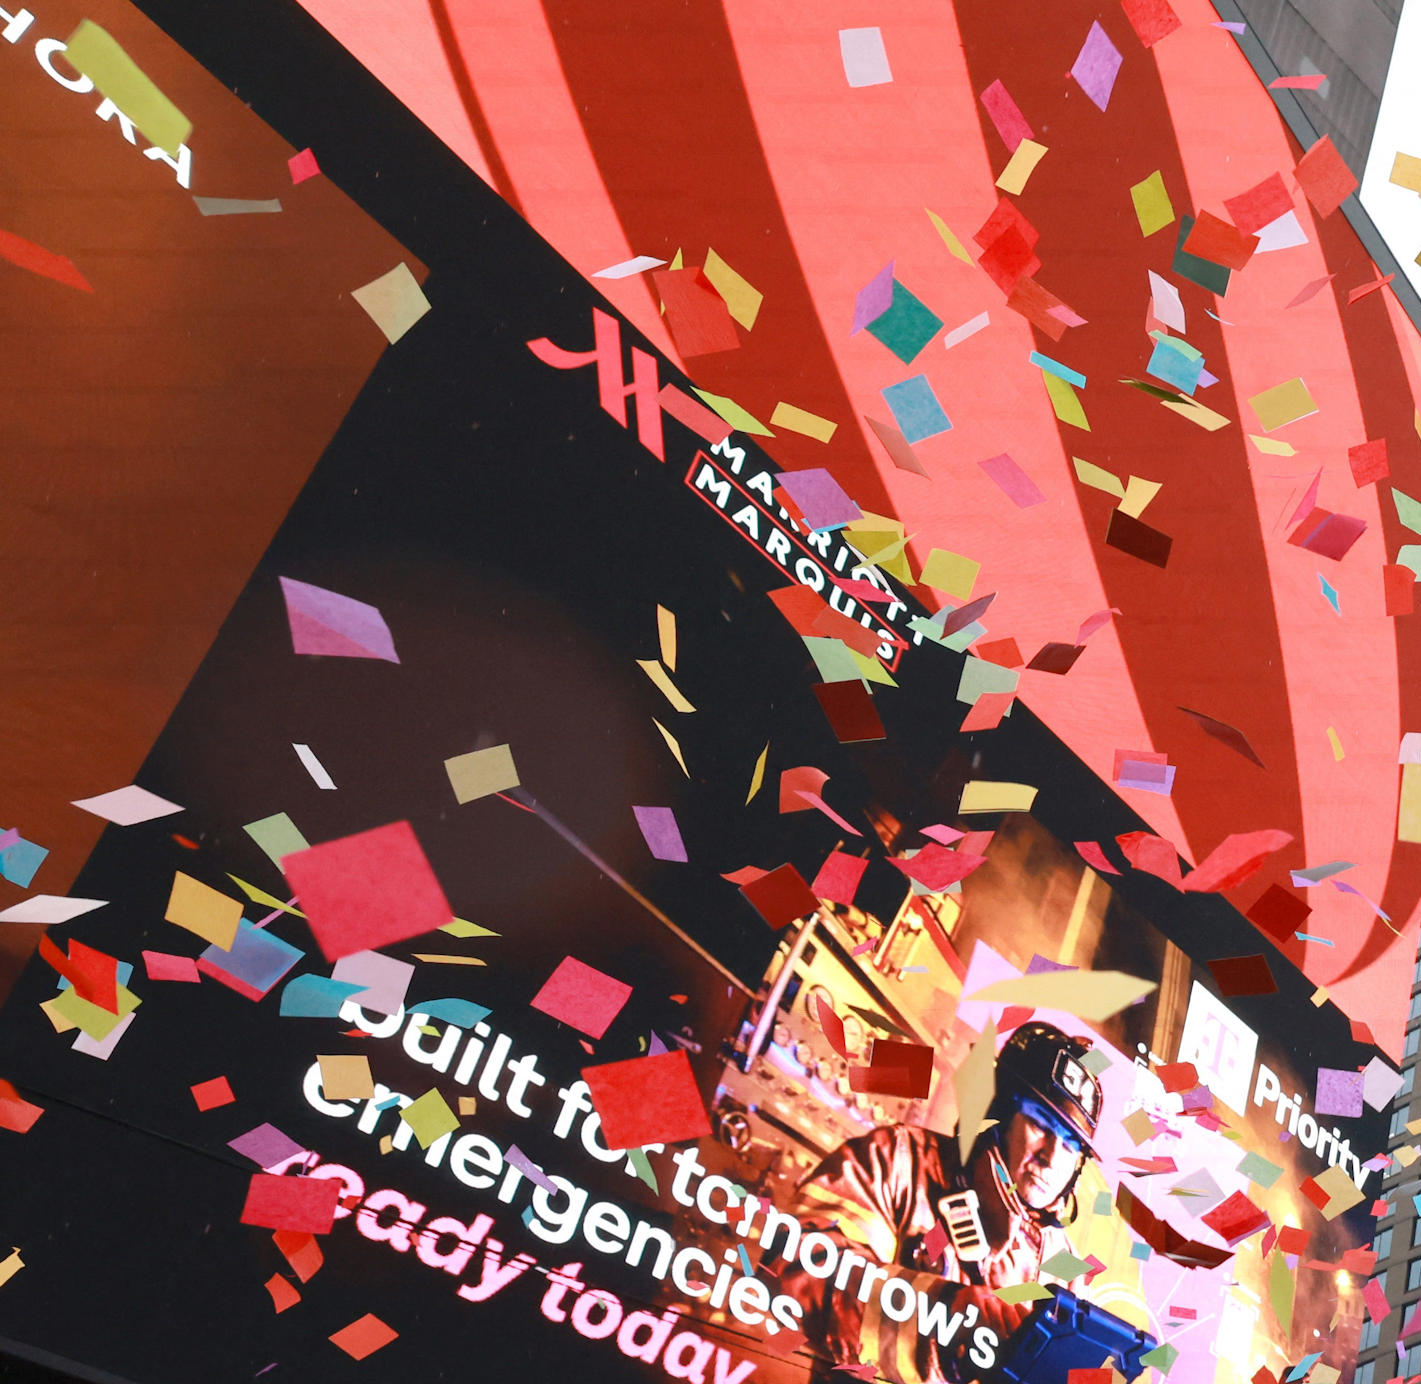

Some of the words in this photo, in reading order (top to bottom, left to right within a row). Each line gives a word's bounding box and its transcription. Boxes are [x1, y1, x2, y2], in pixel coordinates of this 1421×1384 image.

[695, 464, 896, 660] MARQUIS
[710, 436, 925, 646] MARIOT
[303, 1060, 803, 1334] emergencies
[1253, 1064, 1372, 1190] Priority
[671, 1147, 999, 1369] tomorrow's
